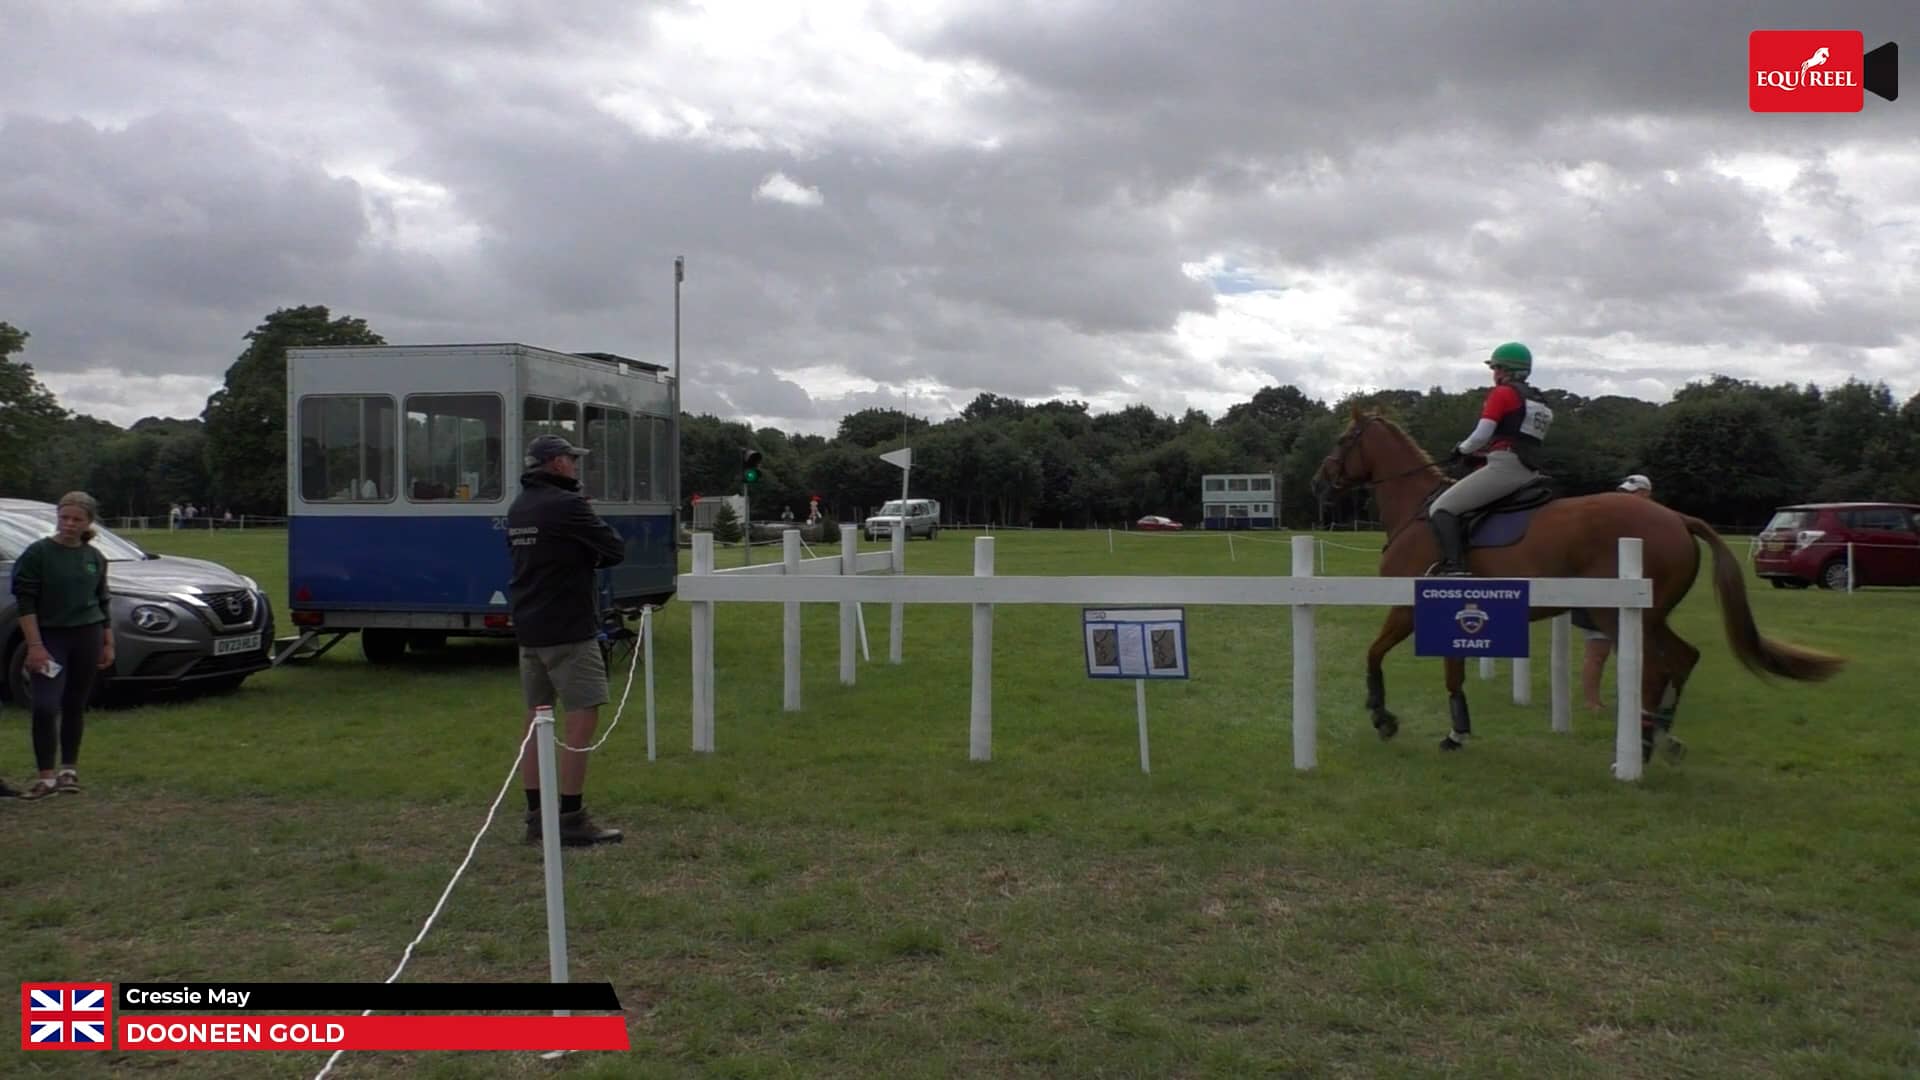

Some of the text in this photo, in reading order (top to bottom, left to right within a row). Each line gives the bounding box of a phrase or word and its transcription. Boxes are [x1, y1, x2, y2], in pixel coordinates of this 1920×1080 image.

[1422, 589, 1521, 599] CROSS COUNTRY
[1453, 639, 1491, 649] START
